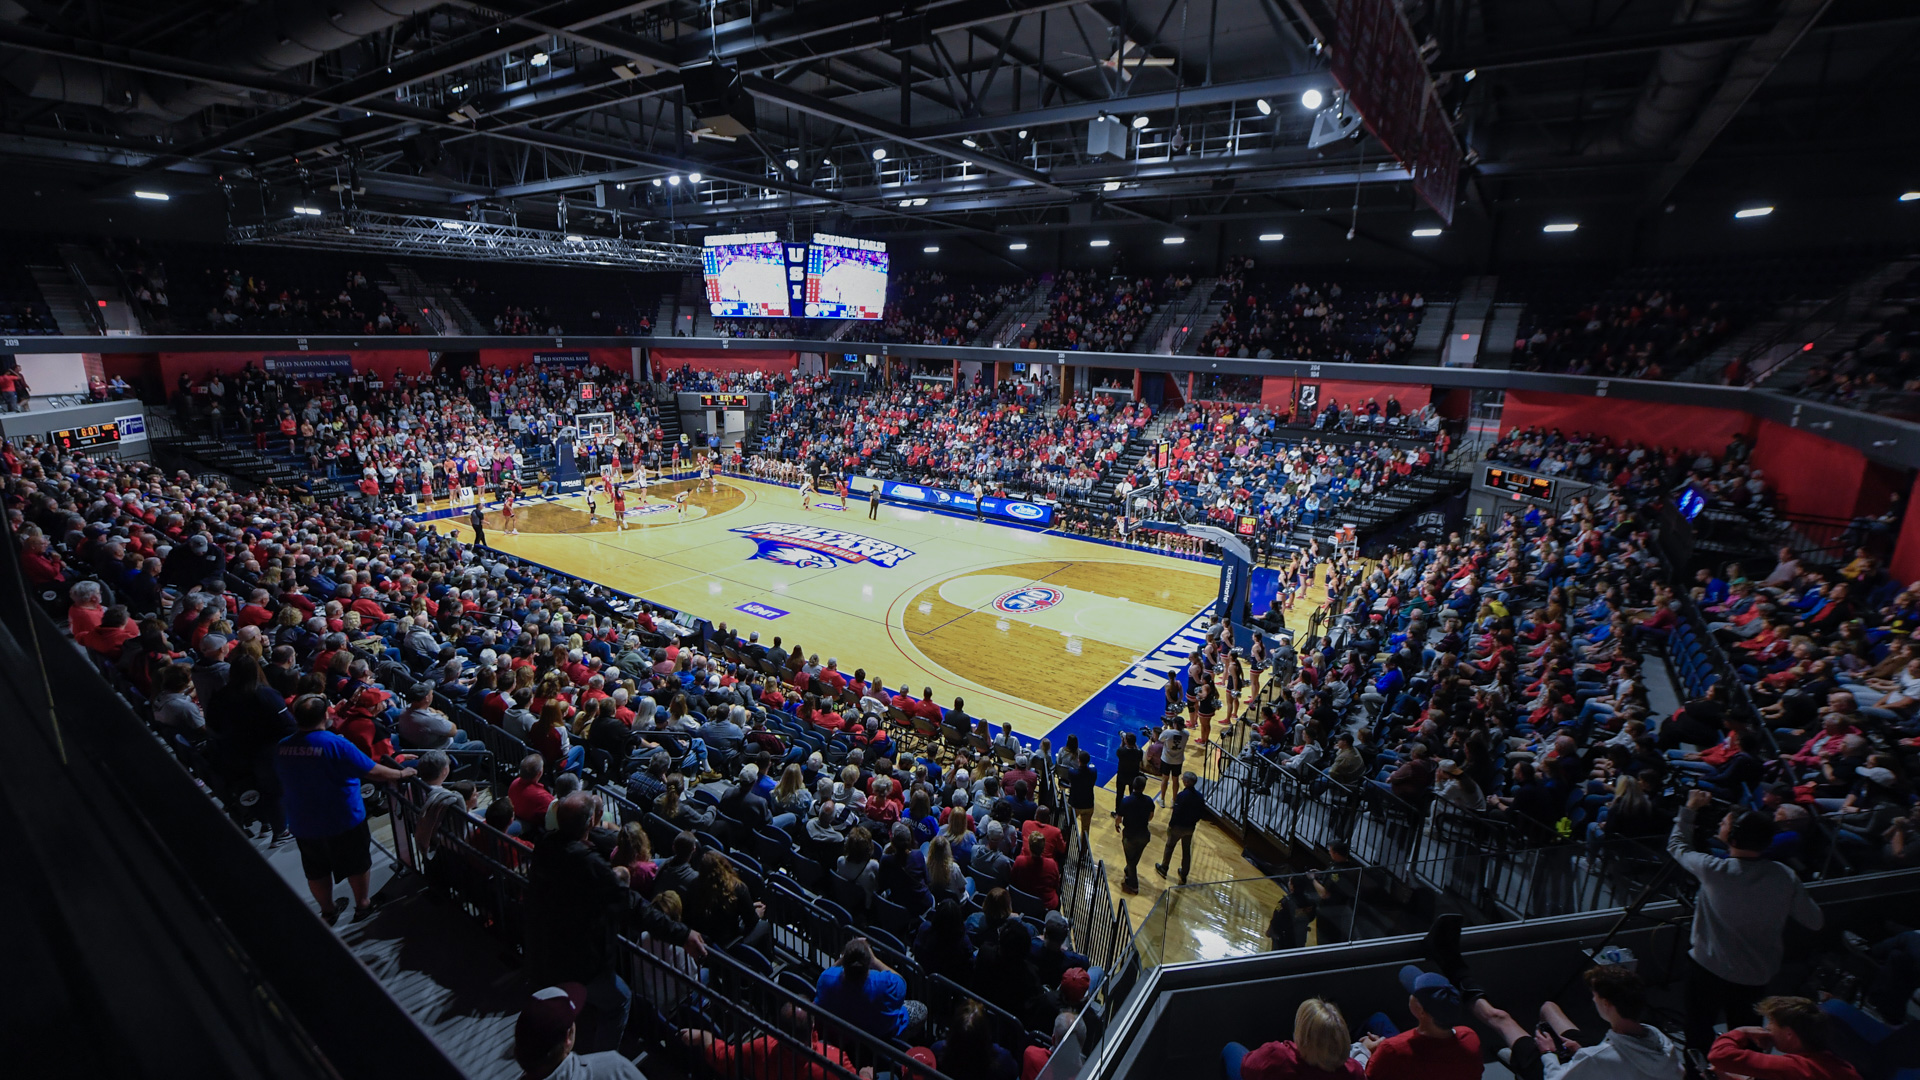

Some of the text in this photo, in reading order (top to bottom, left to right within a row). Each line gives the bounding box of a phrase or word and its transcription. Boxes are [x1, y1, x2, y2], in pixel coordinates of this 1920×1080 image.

[4, 339, 20, 347] 209
[330, 359, 350, 367] BANK
[581, 389, 593, 399] 20
[80, 426, 98, 437] 8:07
[1417, 512, 1443, 527] USI
[1240, 524, 1252, 533] 20
[734, 522, 914, 561] SOUTHERN
[750, 526, 901, 567] INDIANA
[757, 533, 860, 561] SCREAMING EAGLES
[1222, 565, 1234, 605] TicketSmarter
[279, 745, 323, 757] WILSON
